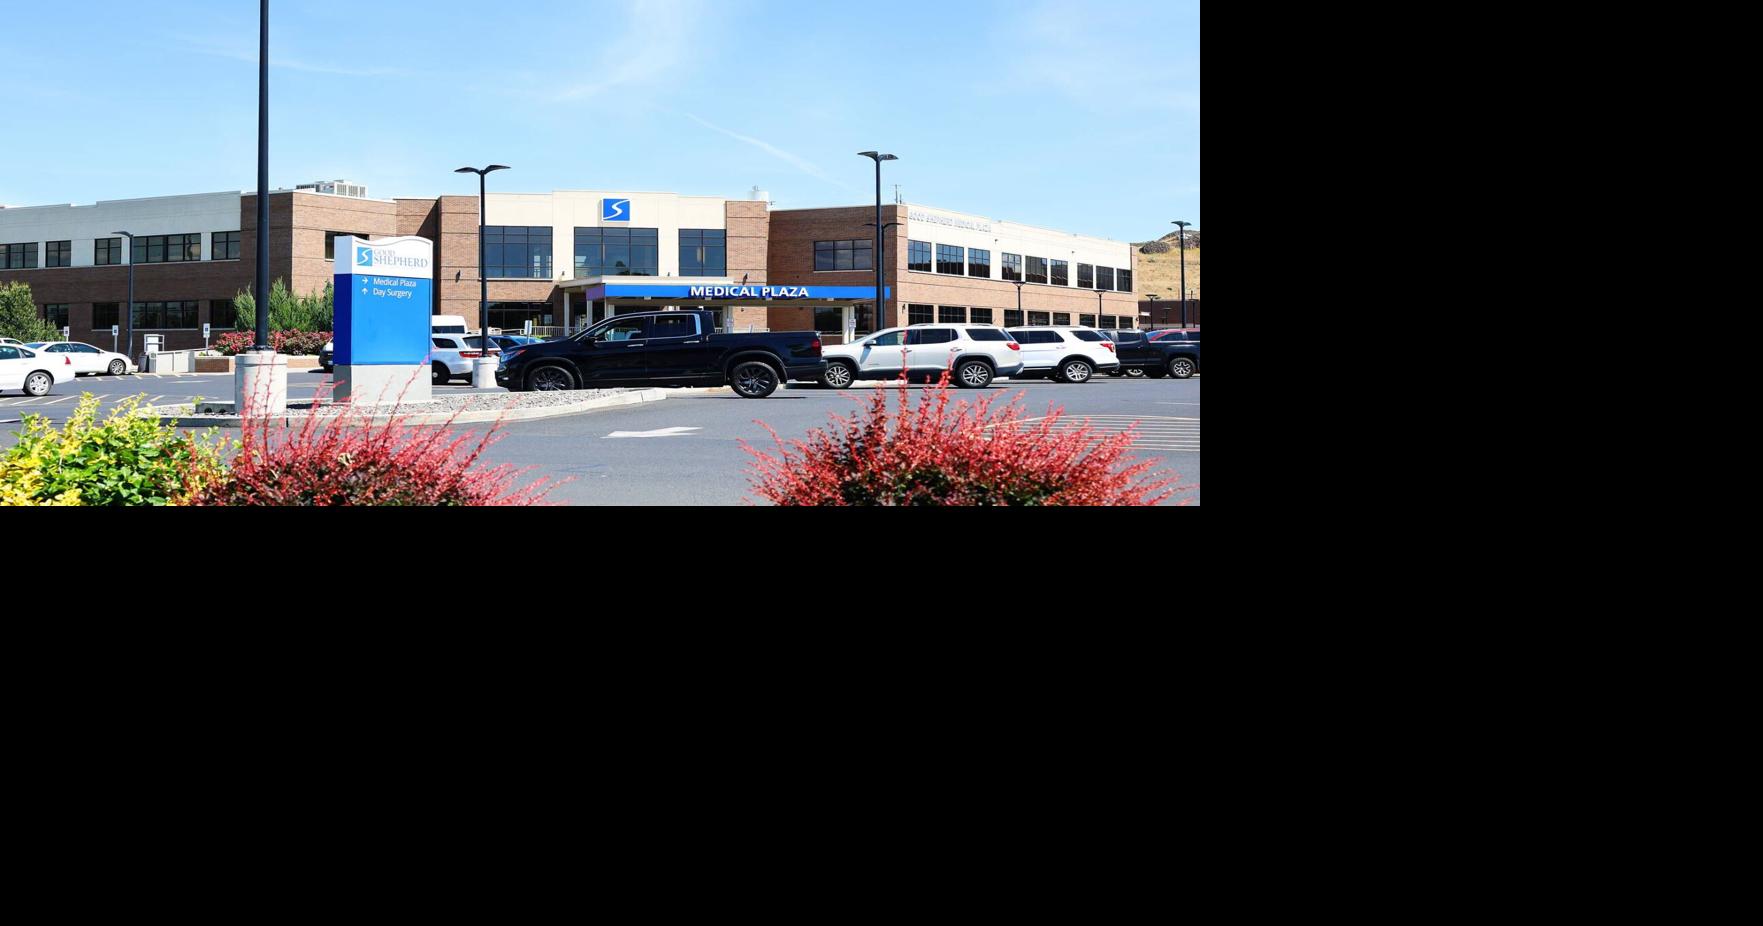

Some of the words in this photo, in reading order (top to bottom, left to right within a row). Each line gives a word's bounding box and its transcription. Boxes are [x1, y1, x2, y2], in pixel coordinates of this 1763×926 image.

[374, 249, 396, 257] GOOD
[374, 256, 428, 268] SHEPHERD
[373, 277, 399, 286] Medical
[400, 279, 417, 288] Plaza
[373, 288, 386, 297] Day
[387, 288, 412, 299] Surgery
[690, 286, 759, 297] MEDICAL
[762, 286, 809, 297] PLAZA
